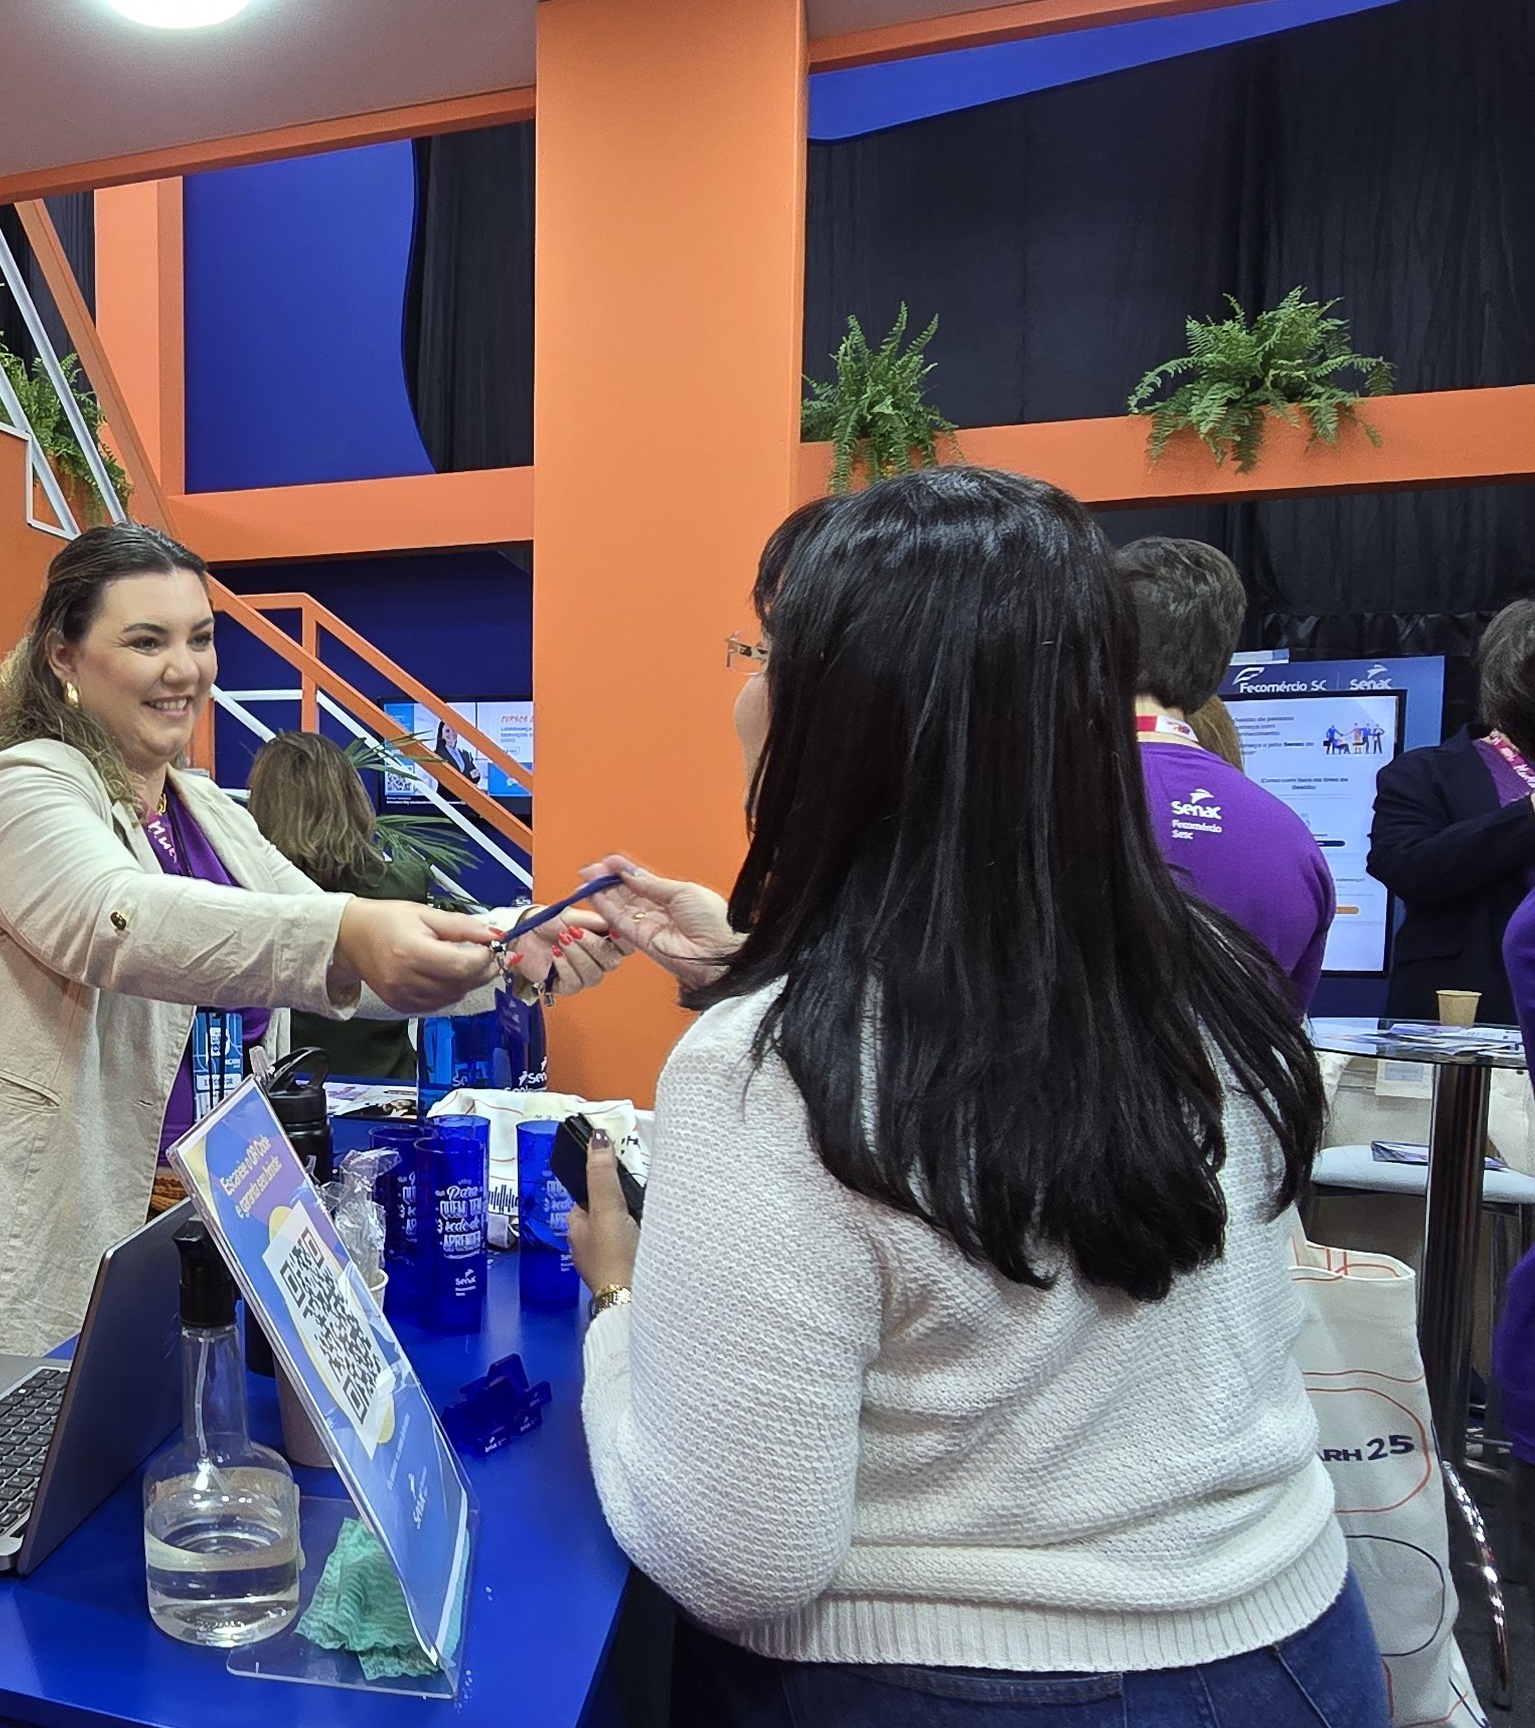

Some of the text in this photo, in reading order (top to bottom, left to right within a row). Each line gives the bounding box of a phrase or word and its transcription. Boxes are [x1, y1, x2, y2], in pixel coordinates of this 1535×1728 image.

[1239, 679, 1327, 693] Fecomércio SC
[1349, 678, 1392, 690] Senac
[1171, 800, 1222, 820] Senac
[1366, 1434, 1415, 1461] 25
